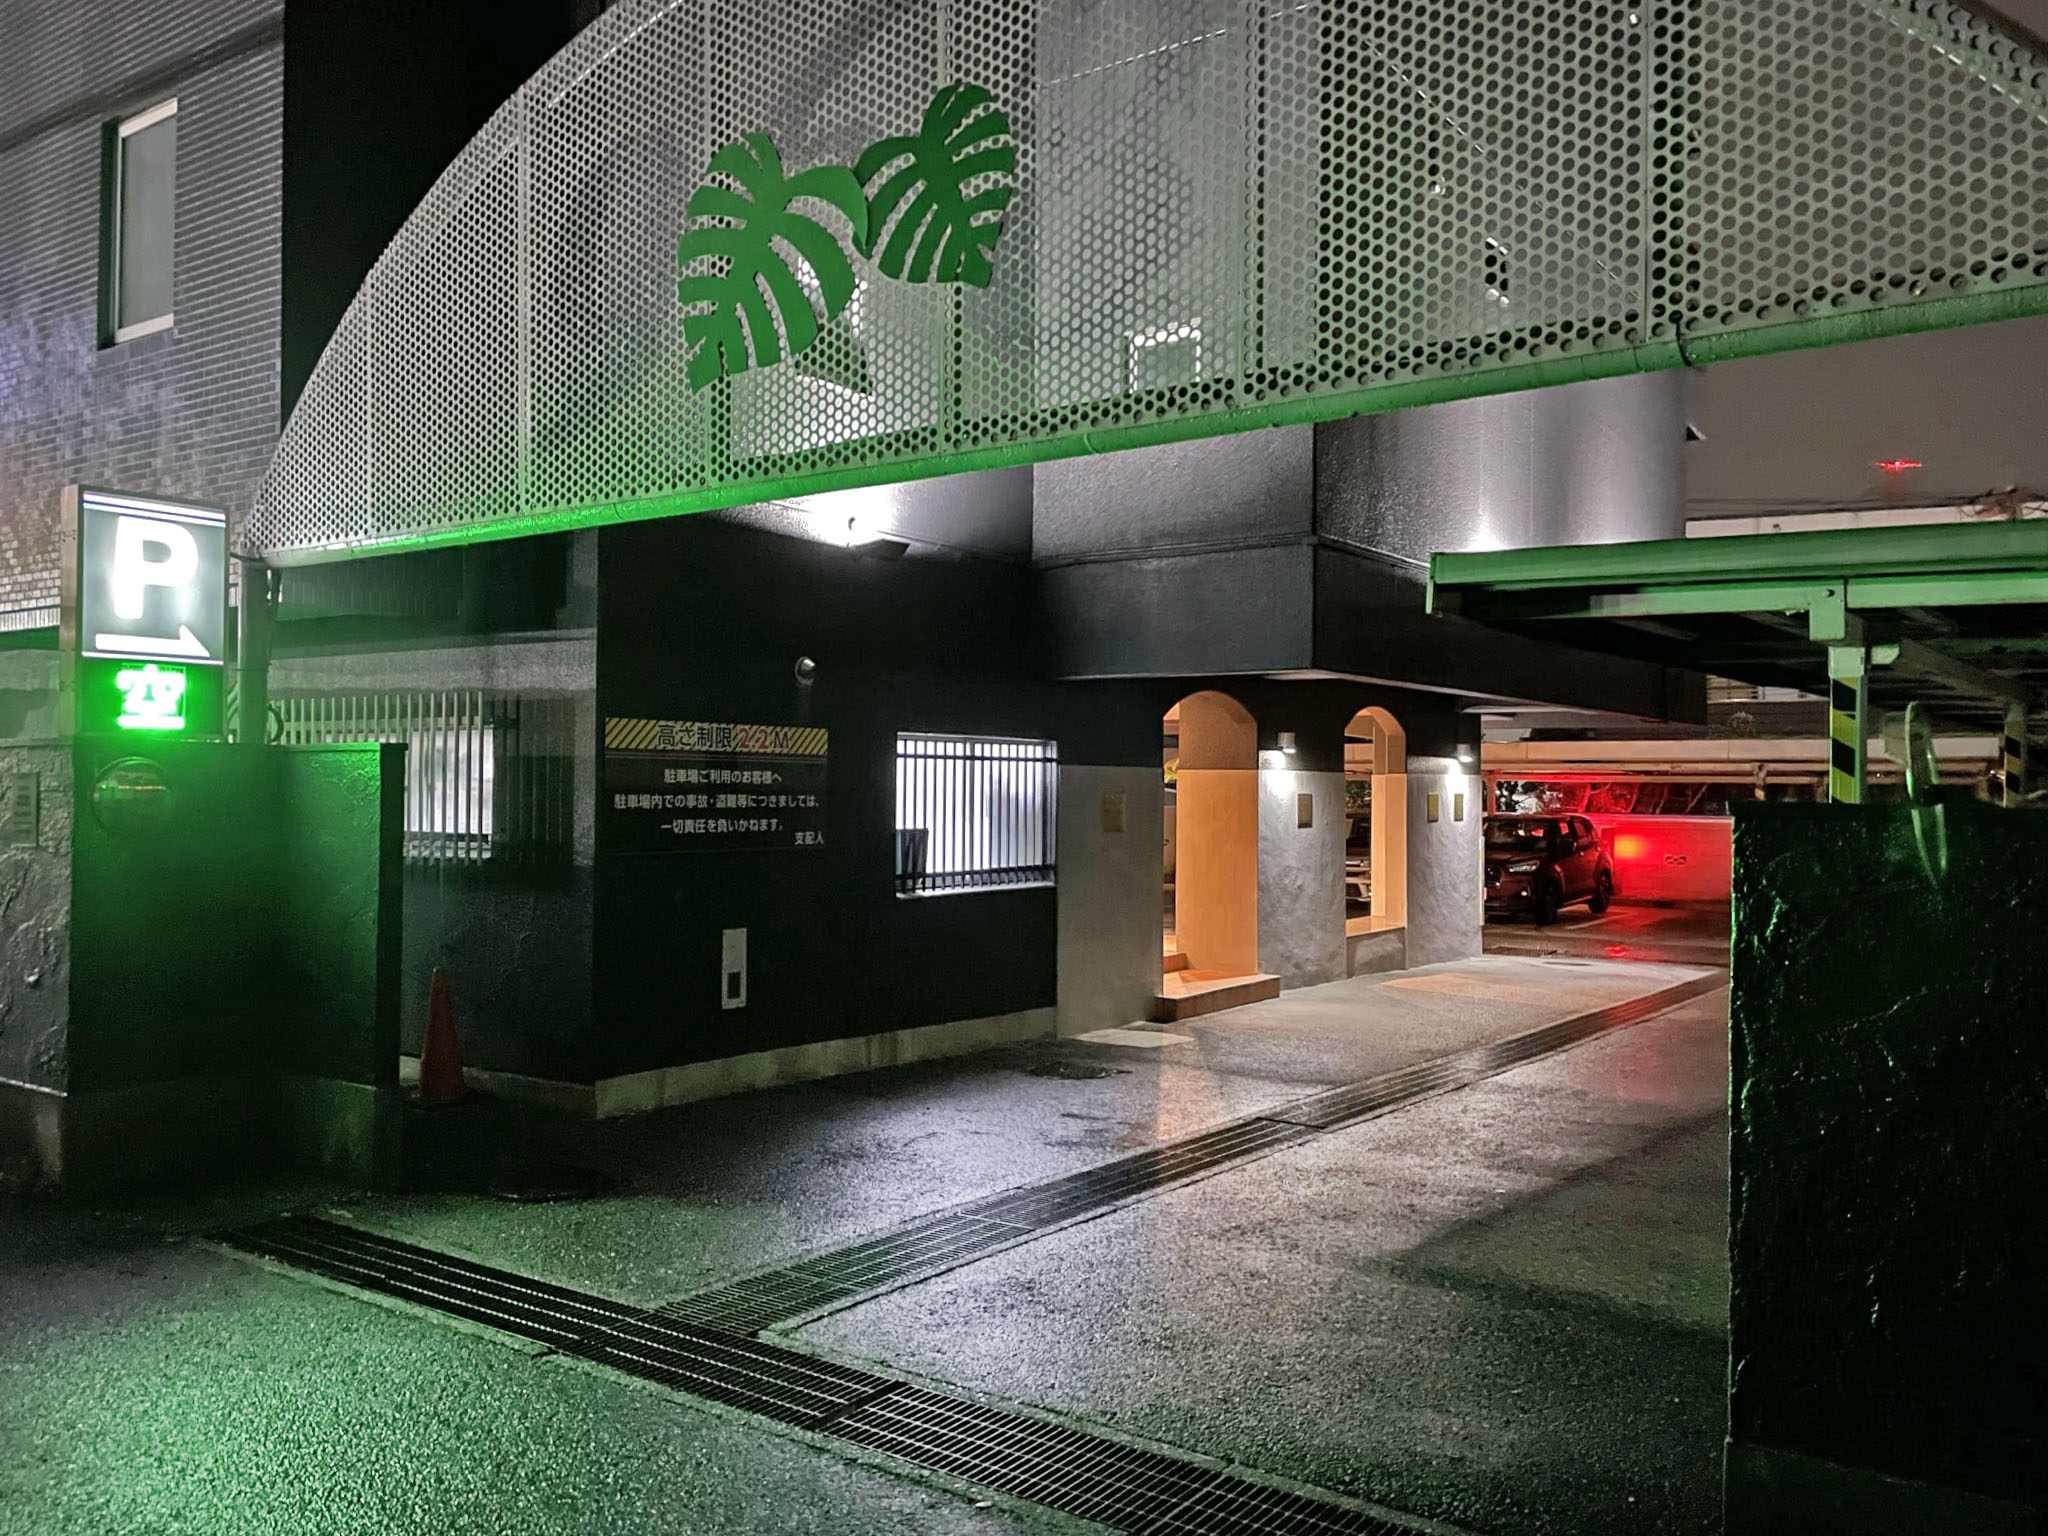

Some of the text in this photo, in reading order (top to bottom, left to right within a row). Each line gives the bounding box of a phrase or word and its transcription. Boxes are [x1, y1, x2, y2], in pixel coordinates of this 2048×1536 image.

[112, 515, 199, 620] P
[116, 663, 186, 730] 空
[664, 768, 782, 785] 駐車場ご利用のお客様へ
[660, 818, 784, 834] 一切責任を負いかねます。
[794, 831, 824, 845] 支配人
